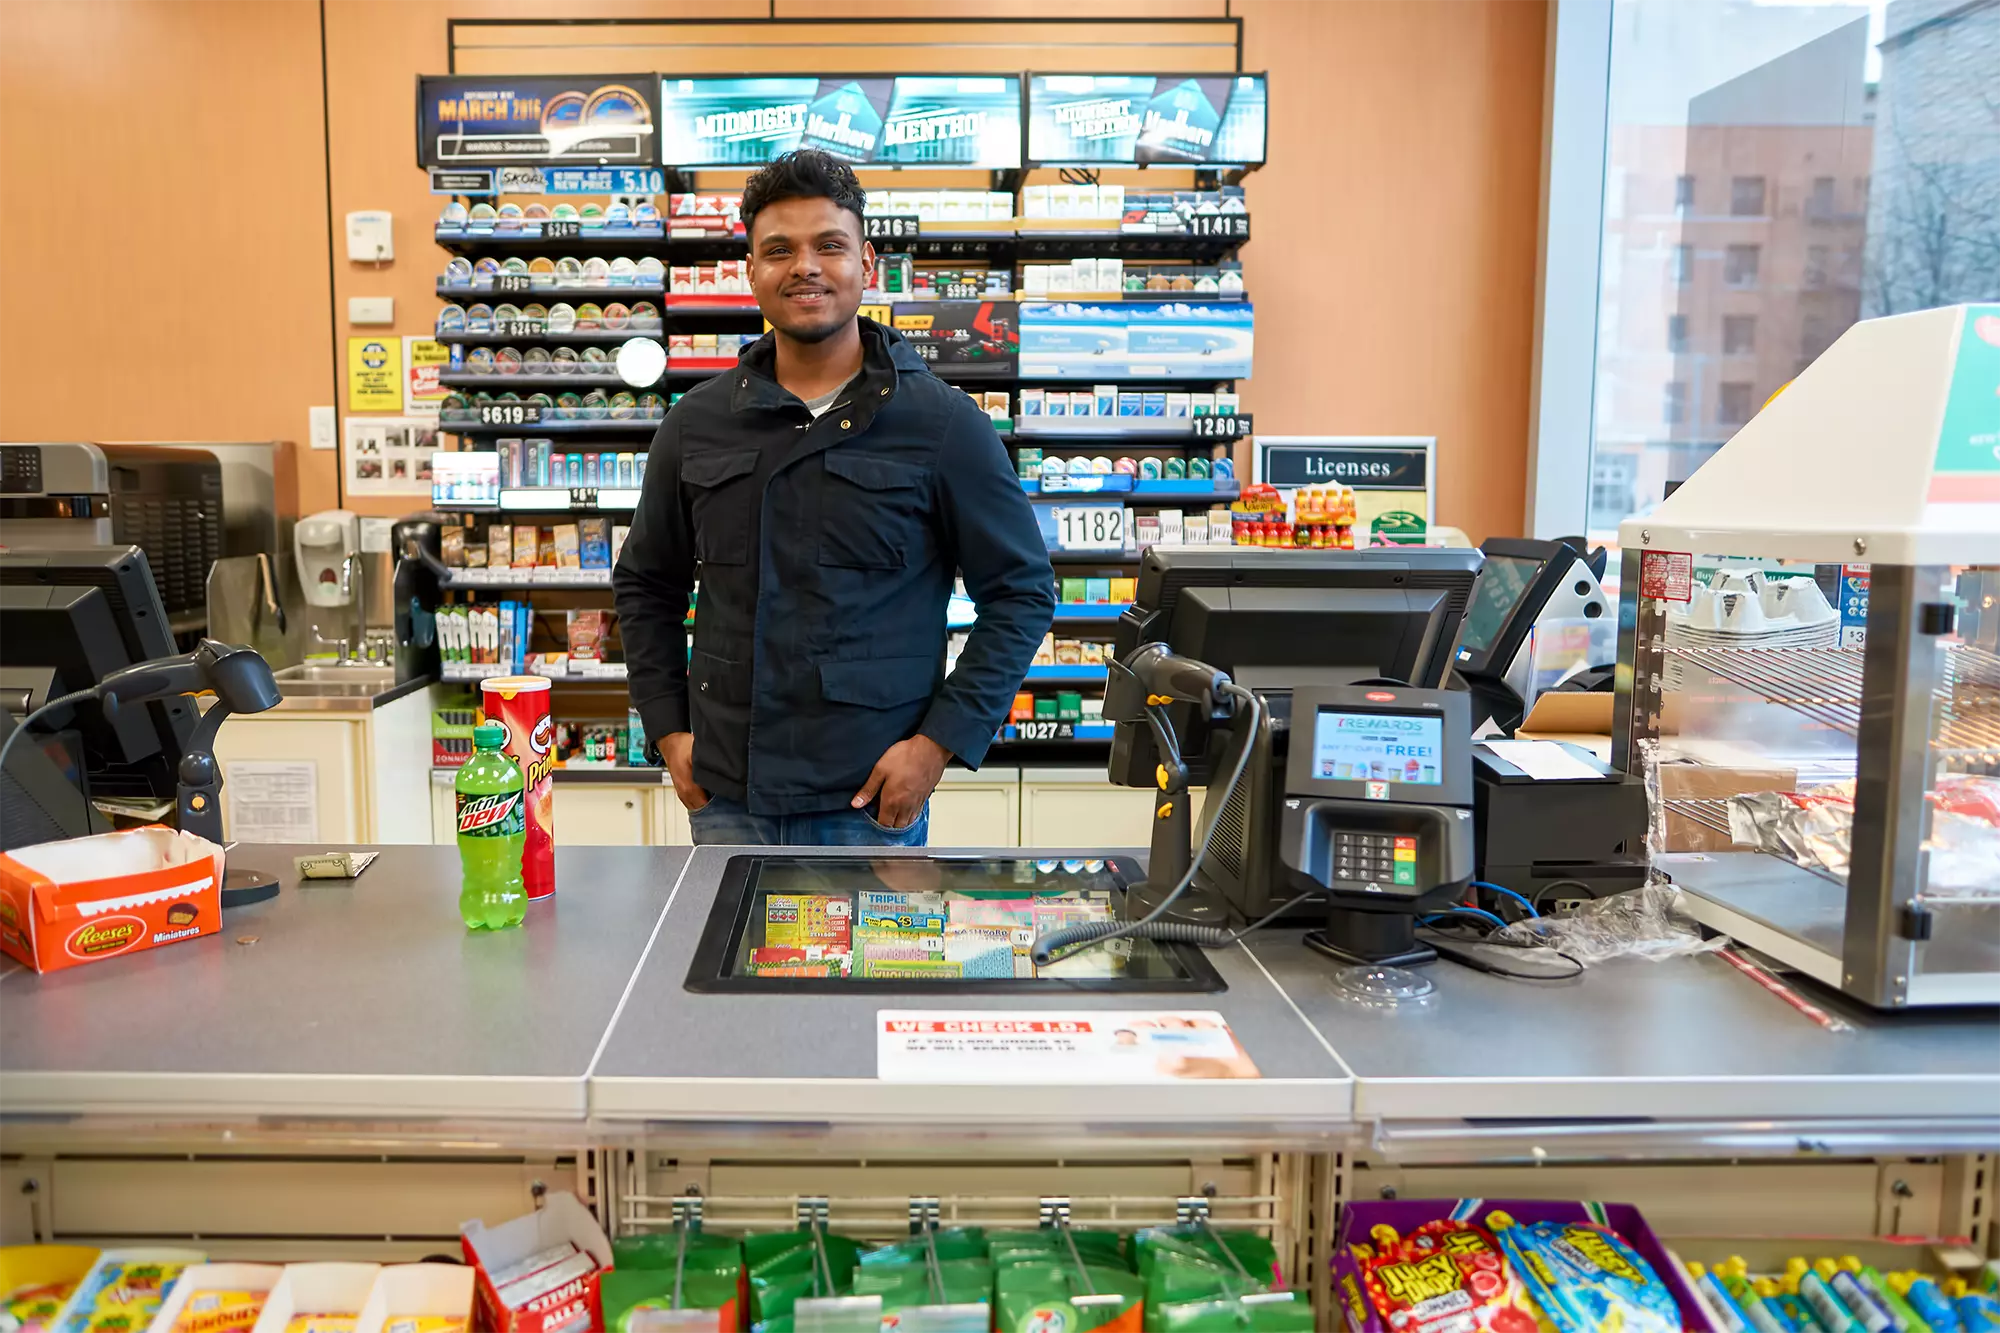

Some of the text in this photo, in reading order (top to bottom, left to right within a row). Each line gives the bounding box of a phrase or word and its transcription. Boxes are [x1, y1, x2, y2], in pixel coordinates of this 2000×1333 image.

[438, 99, 541, 121] MARCH 2016
[695, 104, 808, 138] MIDNIGHT
[1305, 456, 1391, 477] Licenses
[1062, 510, 1122, 543] 1182
[1696, 571, 1713, 582] Buy
[1385, 744, 1433, 758] FREE!
[869, 894, 907, 904] TRIPLE
[836, 905, 842, 913] 4
[153, 926, 201, 944] Miniatures
[1018, 933, 1030, 942] 10
[926, 940, 938, 948] 11
[891, 1021, 935, 1032] WE
[943, 1021, 1034, 1032] CHECK
[1382, 1253, 1457, 1296] JUICY
[1402, 1273, 1455, 1303] DROP
